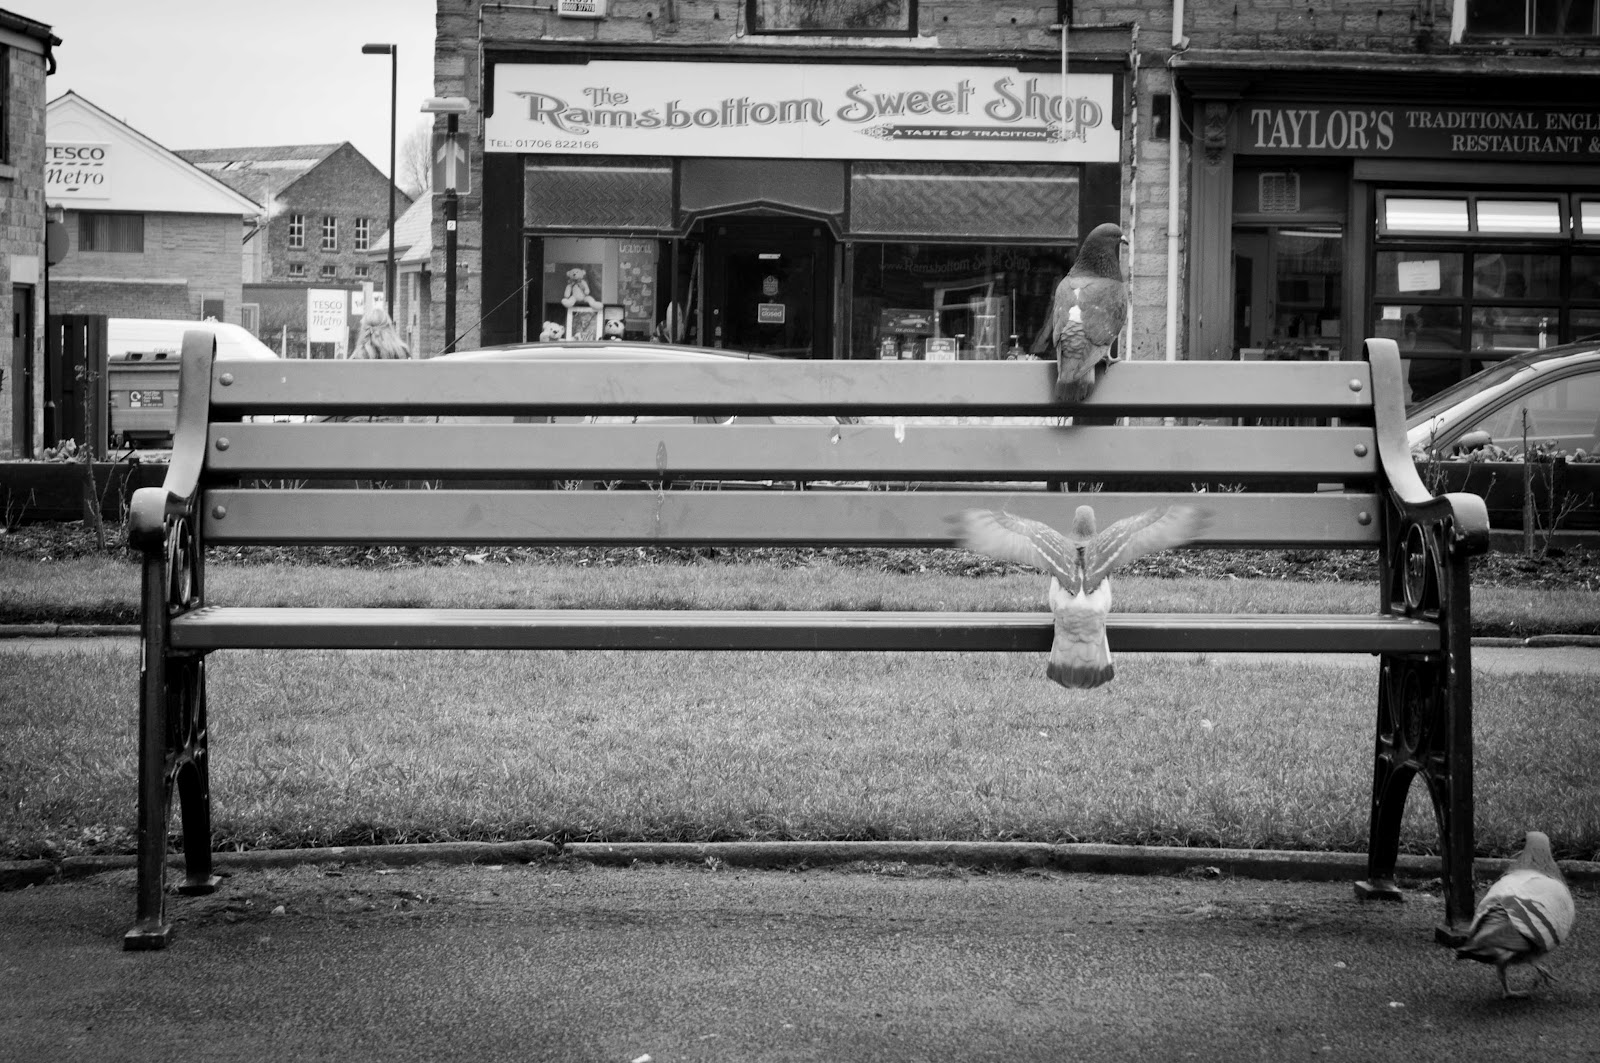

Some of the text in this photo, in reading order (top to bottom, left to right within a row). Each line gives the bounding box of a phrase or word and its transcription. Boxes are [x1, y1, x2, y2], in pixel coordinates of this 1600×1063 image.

[583, 87, 629, 107] The
[509, 76, 1103, 143] Ramsbottom Sweet Shop
[1251, 109, 1394, 150] TAYLOR'S
[1405, 110, 1539, 130] TRADITIONAL
[905, 129, 949, 137] TASTE
[972, 130, 1047, 138] TRADITION
[516, 139, 552, 148] 01706
[555, 141, 599, 149] 822166
[1451, 134, 1600, 153] RESTAURANT &
[312, 301, 343, 310] TESCO
[312, 315, 343, 328] Metro
